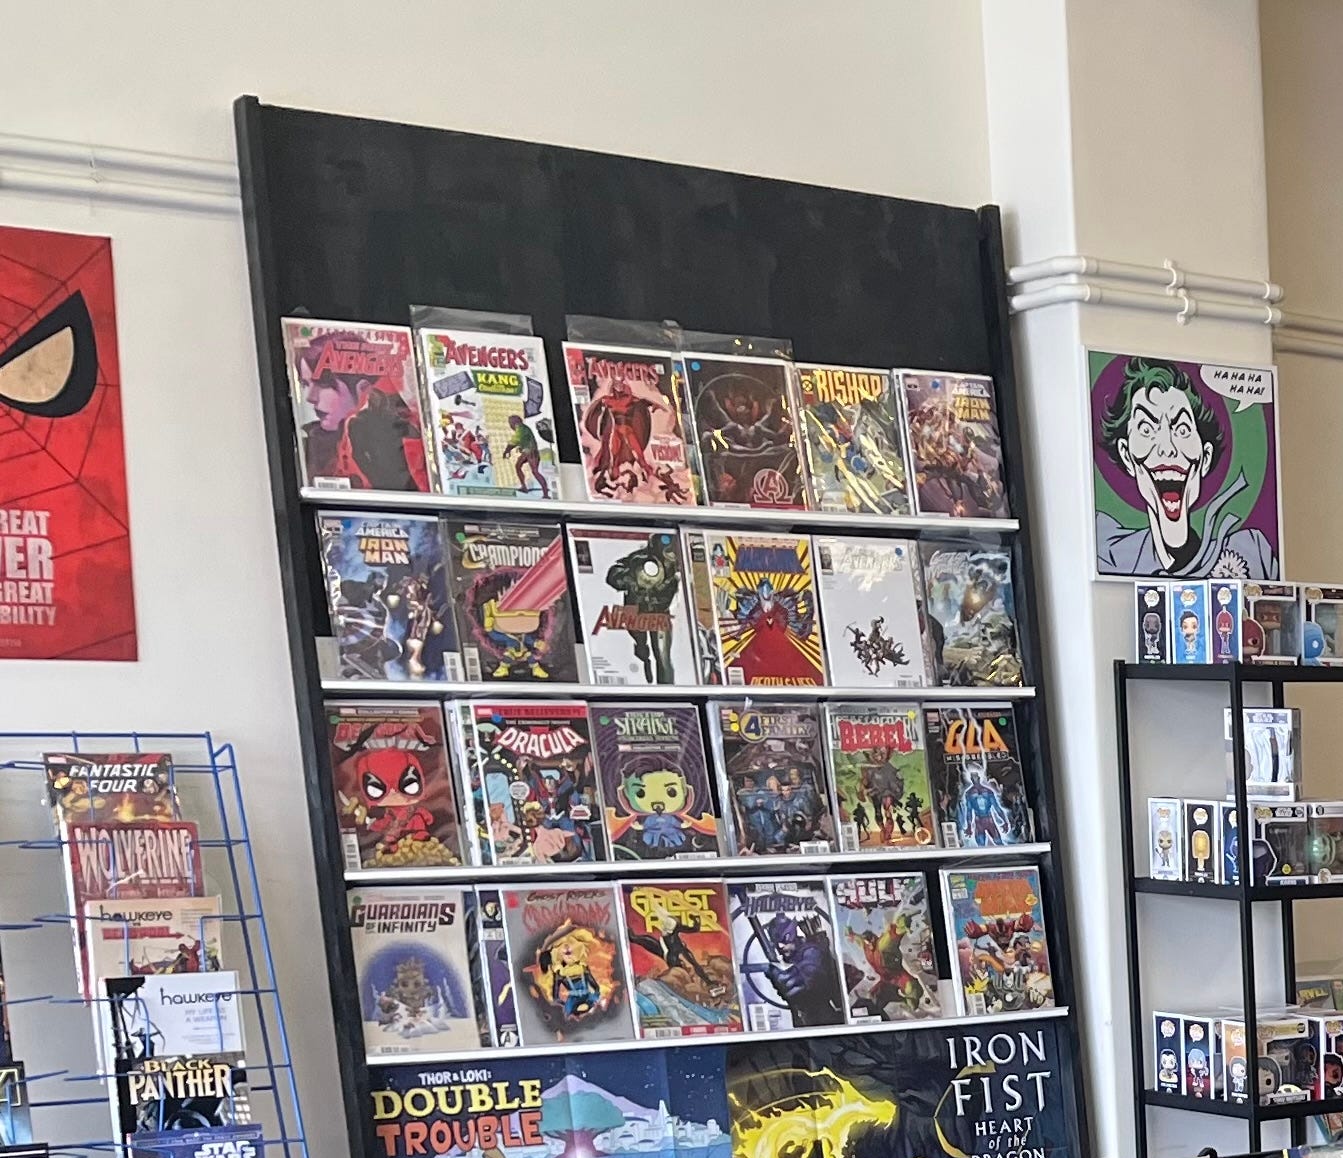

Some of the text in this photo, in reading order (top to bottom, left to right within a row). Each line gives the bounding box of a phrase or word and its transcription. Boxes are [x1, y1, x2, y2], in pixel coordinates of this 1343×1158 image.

[312, 343, 404, 380] AVENGERS
[445, 341, 528, 370] AVENGERS
[476, 373, 519, 386] KANG
[1214, 370, 1263, 383] HA HA HA
[1229, 384, 1245, 394] HA
[359, 538, 410, 552] IRON
[364, 551, 410, 565] MAN
[497, 727, 586, 759] DRACULA
[69, 763, 158, 778] FANTASTIC
[90, 779, 138, 793] FOUR
[74, 826, 193, 886] WOLVERINE
[100, 904, 173, 922] hawkeye
[350, 903, 456, 927] GUARDIANS
[377, 921, 437, 933] INFINITY
[160, 987, 232, 1007] hawkeye
[946, 1030, 1048, 1069] IRON
[143, 1059, 214, 1074] BLACK
[129, 1064, 233, 1105] PANTHER
[418, 1071, 451, 1086] THOR
[461, 1069, 492, 1083] LOKI:
[371, 1079, 543, 1120] DOUBLE
[950, 1071, 1051, 1117] FIST
[375, 1111, 544, 1157] TROUBLE
[974, 1115, 1034, 1136] HEART
[195, 1140, 256, 1157] STAR
[988, 1133, 1027, 1149] of the
